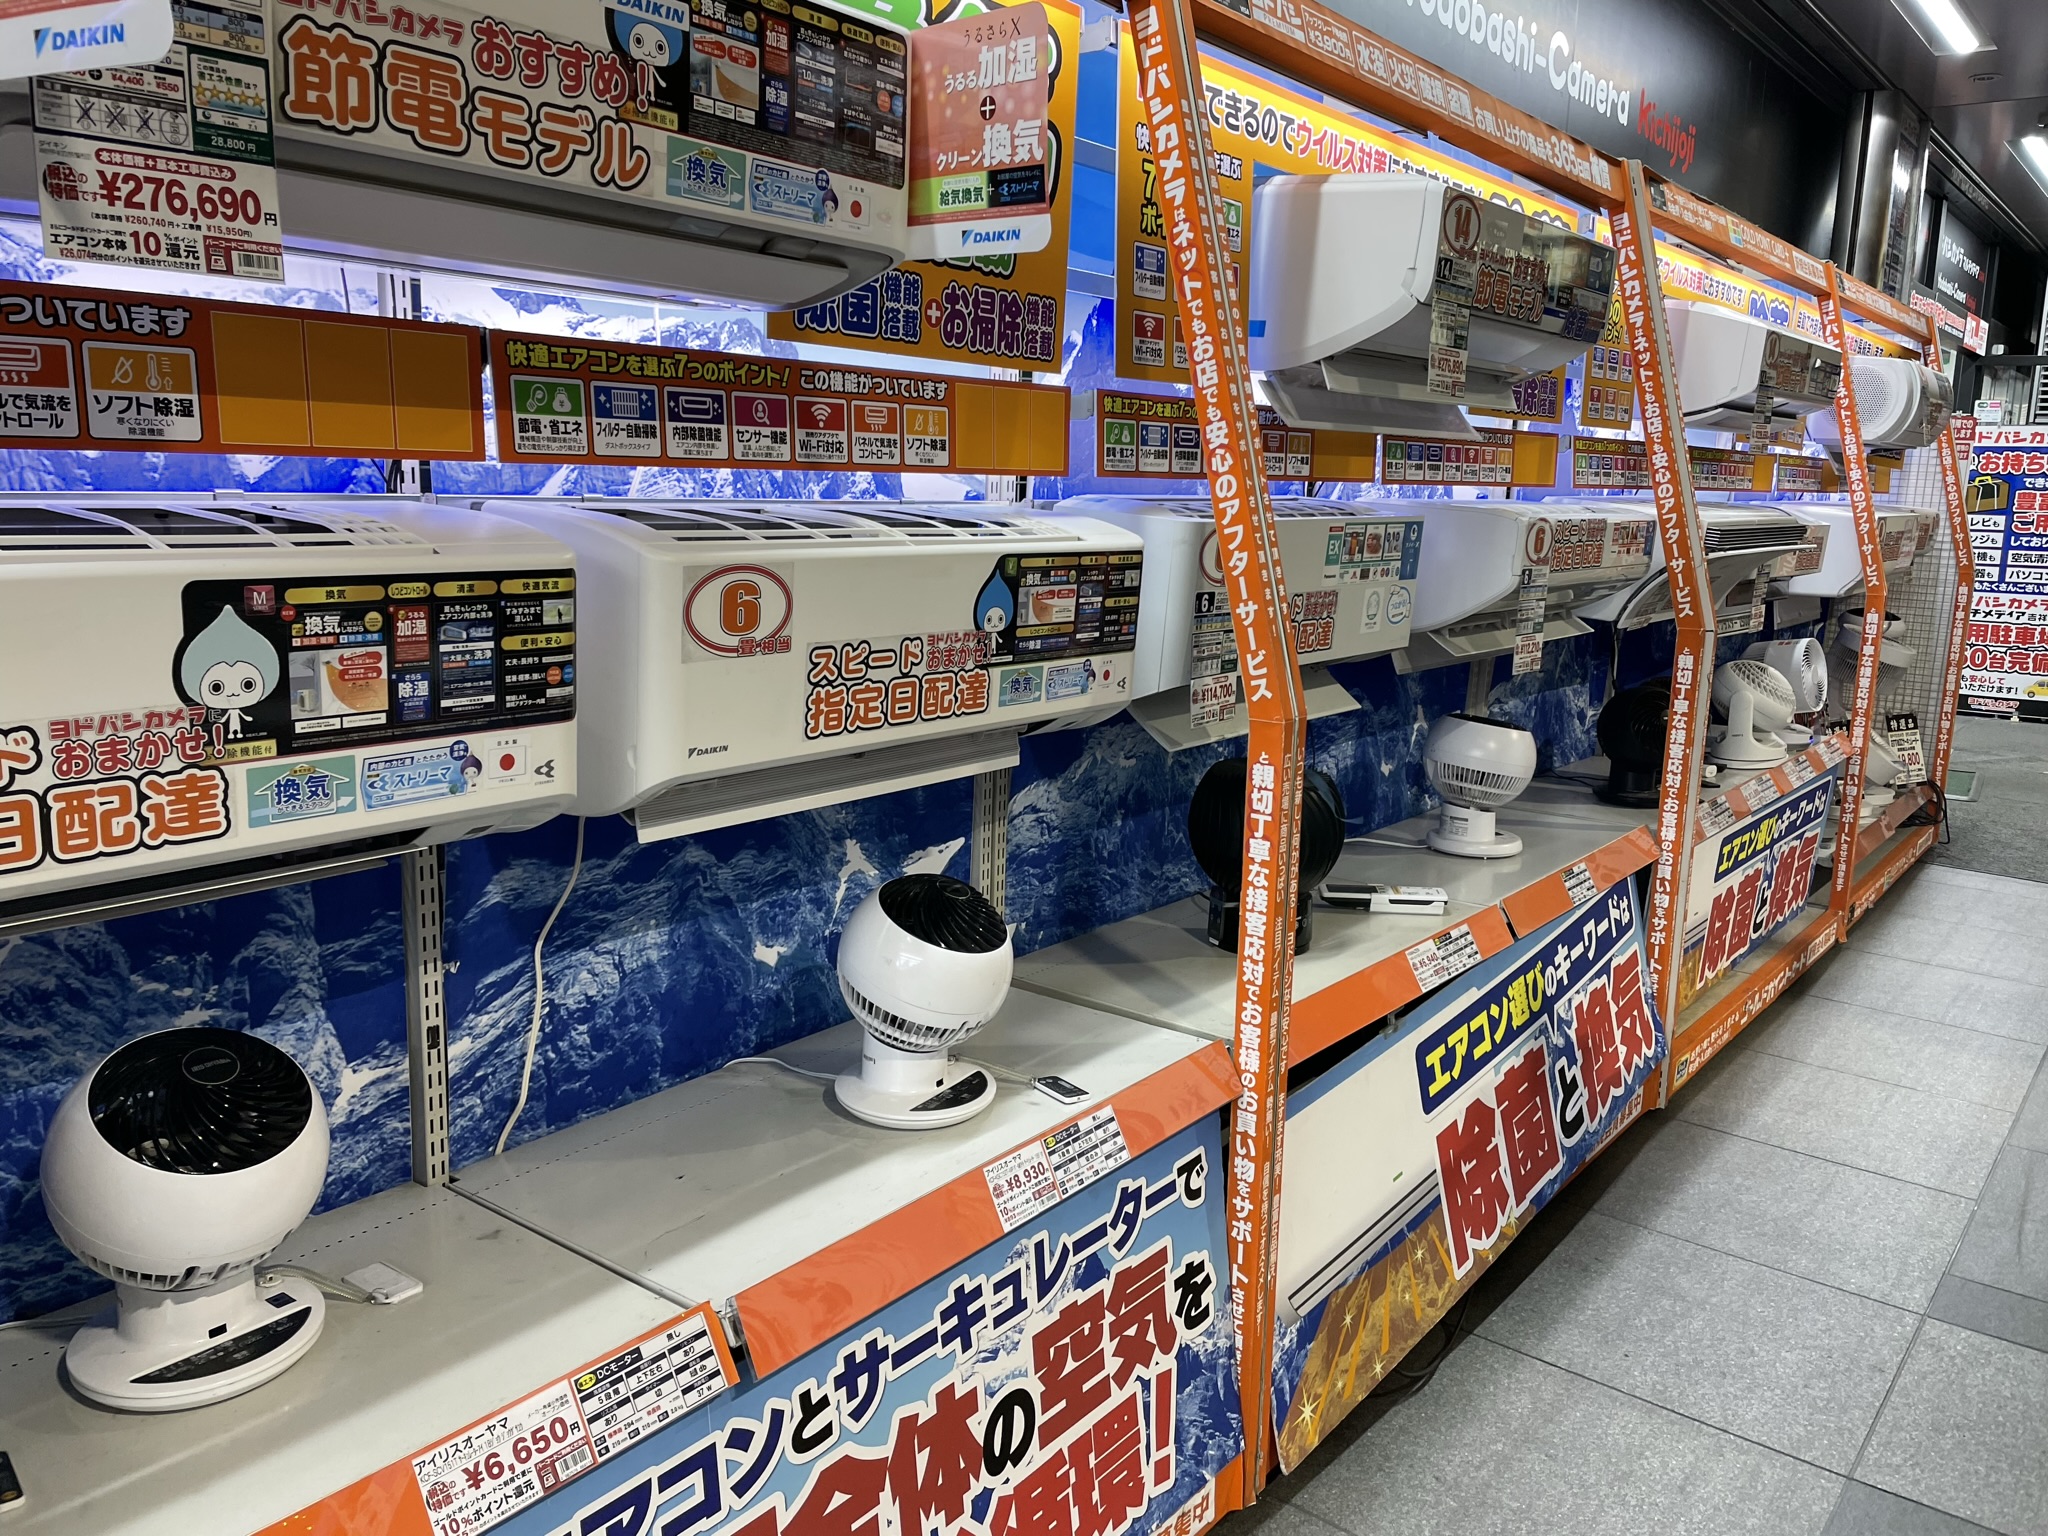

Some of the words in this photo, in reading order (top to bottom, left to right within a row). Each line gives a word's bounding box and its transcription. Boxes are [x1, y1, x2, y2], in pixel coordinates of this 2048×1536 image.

[278, 0, 465, 47] バシカメラ
[1263, 13, 1297, 36] PREMIUM
[51, 23, 124, 50] DAIKIN
[944, 36, 1038, 94] うるる加湿
[111, 72, 144, 87] ¥4,400
[155, 79, 179, 93] ¥550
[282, 17, 650, 189] 節電モデル
[1636, 87, 1697, 175] Kichijoji
[38, 140, 68, 149] ダイキン
[211, 136, 245, 151] 28,800
[936, 119, 1044, 171] クリーン換気
[686, 155, 728, 189] 換気
[772, 184, 816, 206] ストリーマ
[939, 185, 984, 207] 給気換気
[1009, 180, 1039, 193] ストリーマ
[96, 169, 262, 225] ¥276,690
[264, 212, 277, 226] 円
[1454, 204, 1471, 245] 14
[50, 229, 127, 251] エアコン本体
[129, 230, 161, 256] 10
[973, 229, 1021, 244] DAIKIN
[165, 243, 200, 261] 還元
[1439, 259, 1451, 279] 14
[1473, 264, 1544, 325] 節電モデル
[5, 295, 191, 338] ついています
[941, 282, 1024, 357] お掃除
[1134, 344, 1163, 359] Wi-Fi対応
[1135, 6, 1273, 702] ヨドバシカメラはネットでもお店でも安心のアフターサービス
[800, 374, 948, 401] この機能がついています
[93, 394, 195, 419] ソフト除湿
[1612, 212, 1695, 619] ヨドバシカメラはネットでもお店でも安心のアフターサービス
[116, 417, 175, 427] 寒くなりにくい
[128, 427, 165, 437] 除湿機能
[518, 417, 584, 436] 節電・省エネ
[596, 422, 658, 440] フィルター自動掃除
[672, 425, 722, 442] 内部除菌機能
[736, 429, 788, 445] センサー機能
[854, 436, 898, 449] パネルで気流を
[605, 442, 651, 450] ダストボックスタイプ
[799, 439, 844, 454] Wi-Fi対応
[858, 448, 895, 460] コントロール
[906, 437, 947, 452] ソフト除湿
[1106, 446, 1136, 459] 節電・省エネ
[1328, 539, 1341, 556] EX
[1551, 540, 1605, 572] 指定日配達
[522, 581, 559, 591] 快適気流
[1523, 569, 1530, 584] 6
[253, 591, 267, 605] M
[326, 590, 346, 600] 換気
[457, 584, 475, 593] 清潔
[444, 605, 488, 613] 夏も冬もしっかり
[505, 607, 541, 615] すみずみまで
[720, 580, 761, 636] 6
[1201, 594, 1209, 612] 6
[305, 616, 340, 635] 換気
[397, 619, 427, 636] 加湿
[521, 636, 562, 647] 便利・安心
[927, 630, 987, 647] ヨドバシカメラ
[809, 637, 923, 685] スピード
[398, 681, 428, 698] 除湿
[1009, 676, 1033, 695] 換気
[1058, 676, 1084, 688] ストリーマ
[1201, 683, 1233, 703] ¥114,700
[805, 667, 990, 740] 指定日配達
[1889, 717, 1915, 731] 特選品
[53, 724, 226, 780] おまかせ！
[496, 739, 518, 747] 日本製
[696, 745, 729, 756] DAIKIN
[1835, 607, 1879, 892] と親切丁寧な接客応対でお客様のお買い物をサポートさせて頂きます
[369, 758, 412, 772] 内部のカビ菌
[416, 752, 448, 765] とたたかう
[393, 766, 452, 788] ストリーマ
[274, 774, 331, 806] 換気
[276, 800, 332, 814] ができるエアコン
[1718, 790, 1825, 871] エアコン選びのキーワードは
[1697, 832, 1820, 988] 除菌と換気
[1417, 951, 1439, 969] ¥6,940
[1426, 895, 1631, 1097] エアコン選びのキーワードは
[1436, 947, 1654, 1271] 除菌と換気
[1054, 1125, 1078, 1142] DCモーター
[985, 1153, 1021, 1177] アイリスオーヤマ
[1005, 1160, 1047, 1194] ¥8,930
[998, 1206, 1009, 1218] 10
[555, 1161, 1206, 1536] アコンとサーキュレーターで
[679, 1336, 695, 1348] リモコン
[596, 1351, 639, 1379] DCモーター
[665, 1328, 681, 1342] 無し
[634, 1364, 663, 1384] 上下左右
[681, 1345, 695, 1358] あり
[602, 1413, 618, 1426] あり
[653, 1387, 663, 1398] 切
[697, 1362, 708, 1373] db
[644, 1379, 661, 1391] タイマー
[541, 1398, 570, 1418] オープン価格
[610, 1438, 621, 1448] 210
[641, 1421, 651, 1431] 210
[695, 1387, 705, 1397] 37
[622, 1419, 634, 1430] 294
[415, 1416, 510, 1475] アイリスオーヤマ
[461, 1414, 572, 1493] ¥6,650
[568, 1420, 581, 1435] 円
[418, 1456, 458, 1483] KCF-SCV151T
[425, 1477, 456, 1500] 税込の
[432, 1466, 533, 1526] ゴールドポイントカードご利用で更に
[430, 1486, 467, 1513] 特価です
[438, 1516, 462, 1536] 10
